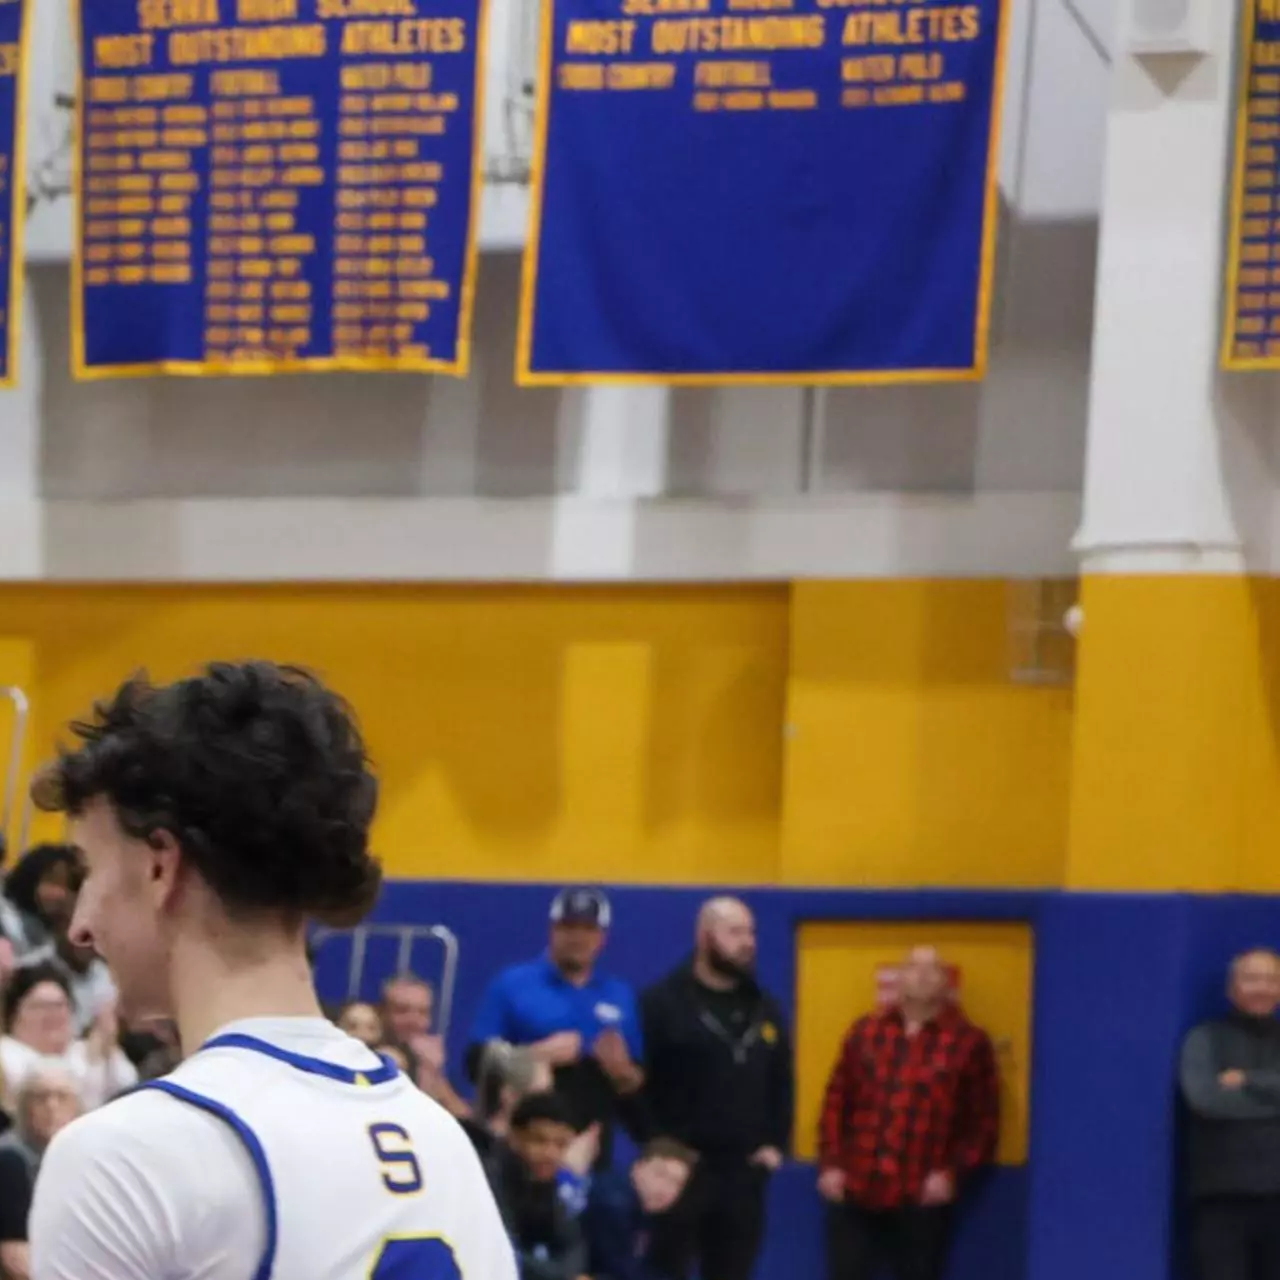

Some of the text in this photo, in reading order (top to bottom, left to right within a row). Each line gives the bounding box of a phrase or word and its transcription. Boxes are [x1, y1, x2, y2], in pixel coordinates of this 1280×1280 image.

[342, 18, 465, 54] ATHLETES
[566, 6, 980, 54] MOST OUTSTANDING ATHLETES
[366, 1121, 425, 1195] S
